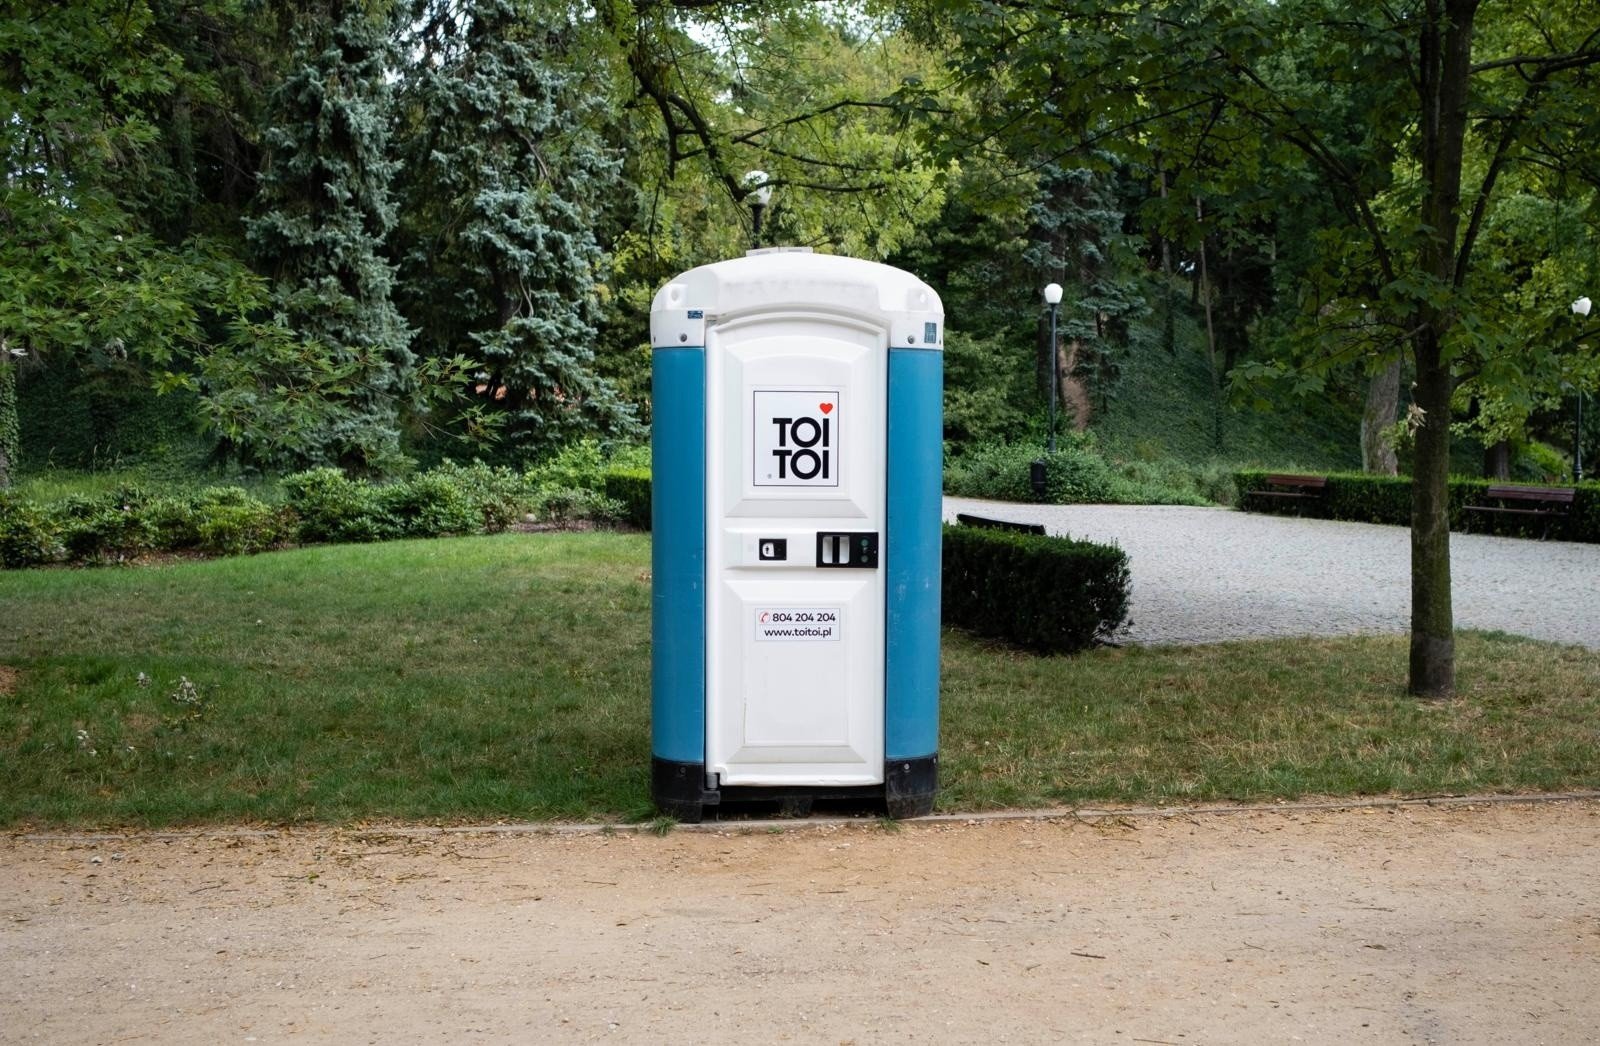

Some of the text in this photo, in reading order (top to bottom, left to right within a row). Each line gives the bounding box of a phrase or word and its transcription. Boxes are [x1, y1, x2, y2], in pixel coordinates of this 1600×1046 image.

[772, 416, 830, 448] TOI
[772, 448, 829, 480] TOI
[772, 612, 836, 622] 804 204 204
[764, 627, 832, 639] www.toitoi.pl
